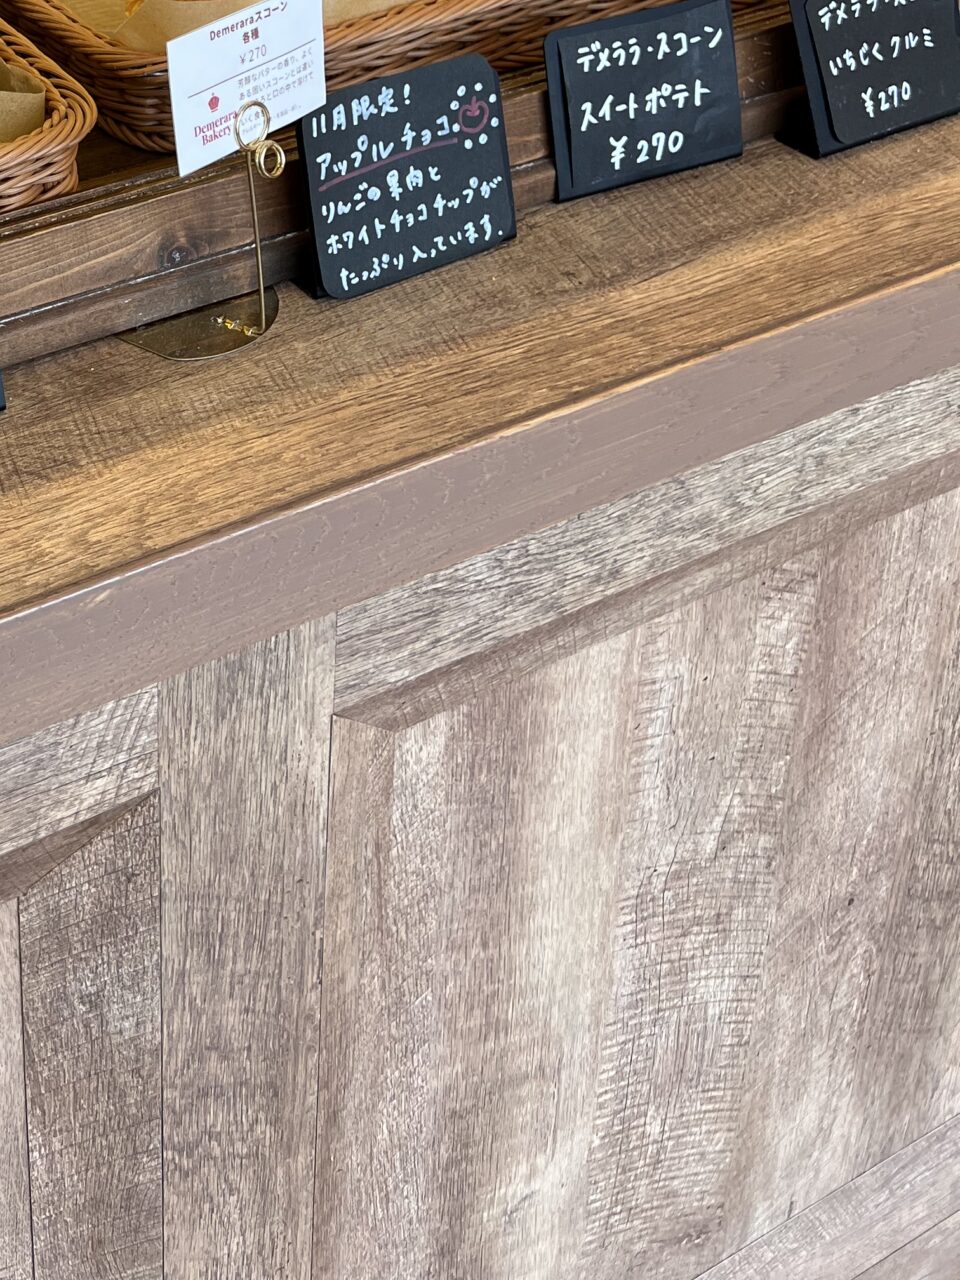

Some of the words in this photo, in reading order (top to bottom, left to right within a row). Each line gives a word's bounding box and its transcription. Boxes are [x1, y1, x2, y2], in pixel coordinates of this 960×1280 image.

[209, 1, 288, 41] Demeraraスコーン
[242, 30, 260, 44] 各種
[239, 44, 267, 65] ¥270
[580, 79, 711, 132] スイートポテト
[861, 81, 911, 118] ¥270
[194, 109, 239, 137] Demerara
[202, 125, 231, 146] Bakery
[316, 115, 450, 180] アップルチョコ
[609, 131, 683, 170] ¥270
